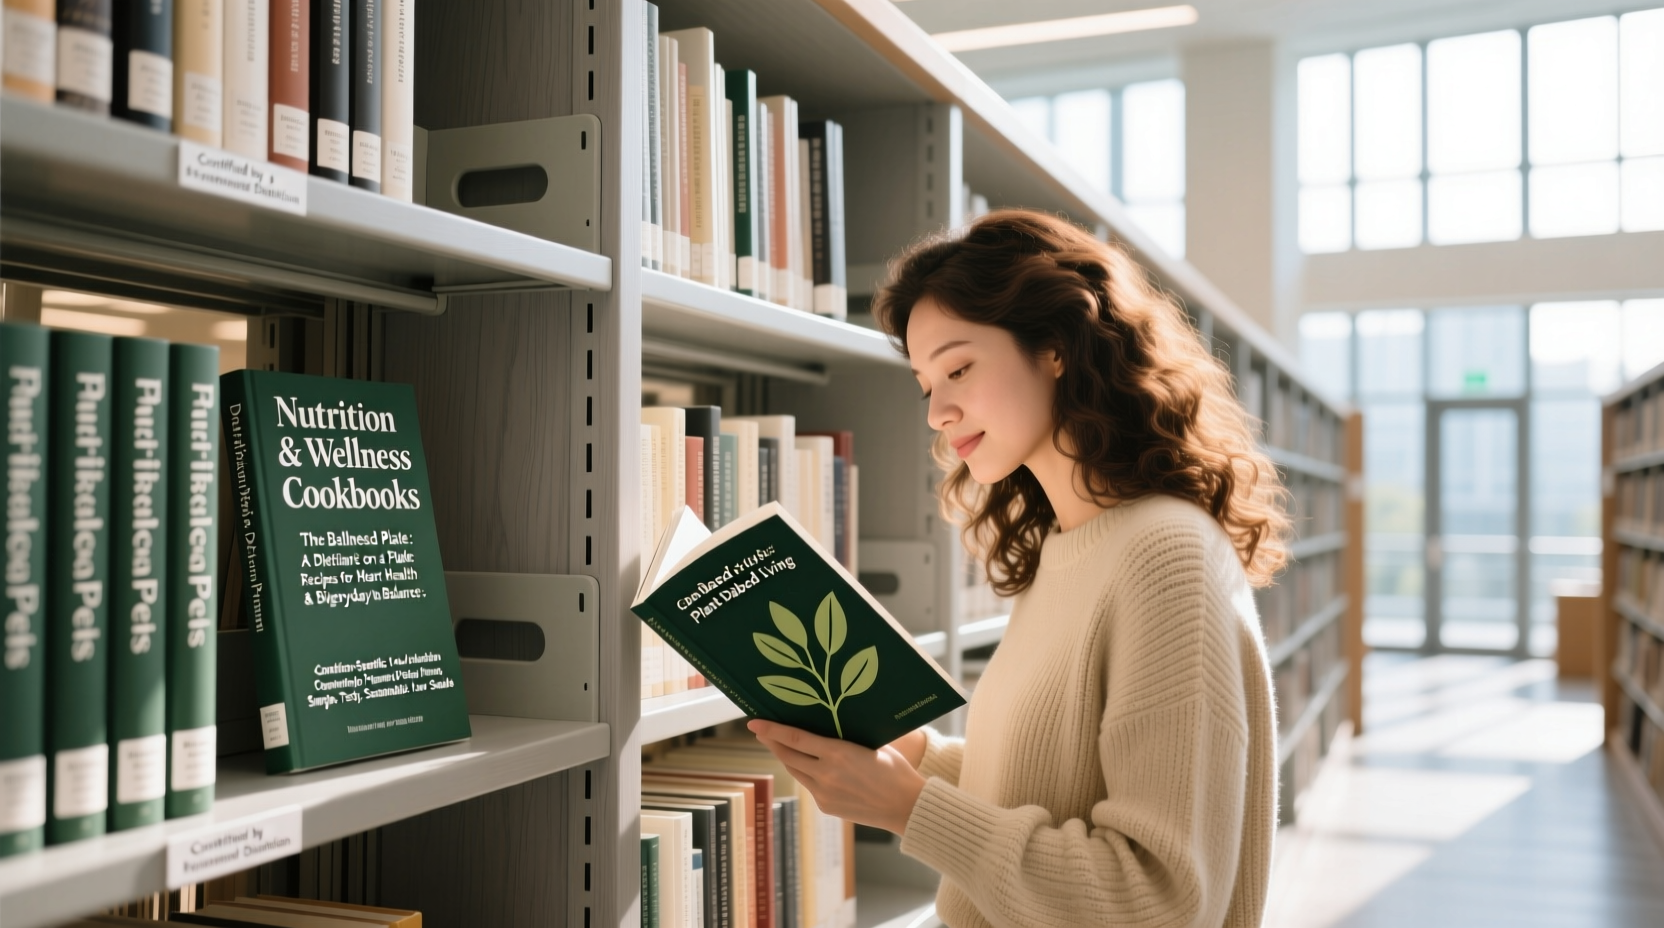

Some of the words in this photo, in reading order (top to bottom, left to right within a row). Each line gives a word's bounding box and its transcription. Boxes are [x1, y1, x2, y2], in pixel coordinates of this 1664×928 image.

[273, 396, 397, 433] Nutrition
[278, 436, 303, 467] &
[303, 436, 412, 470] Wellness
[282, 476, 420, 510] Cookbooks
